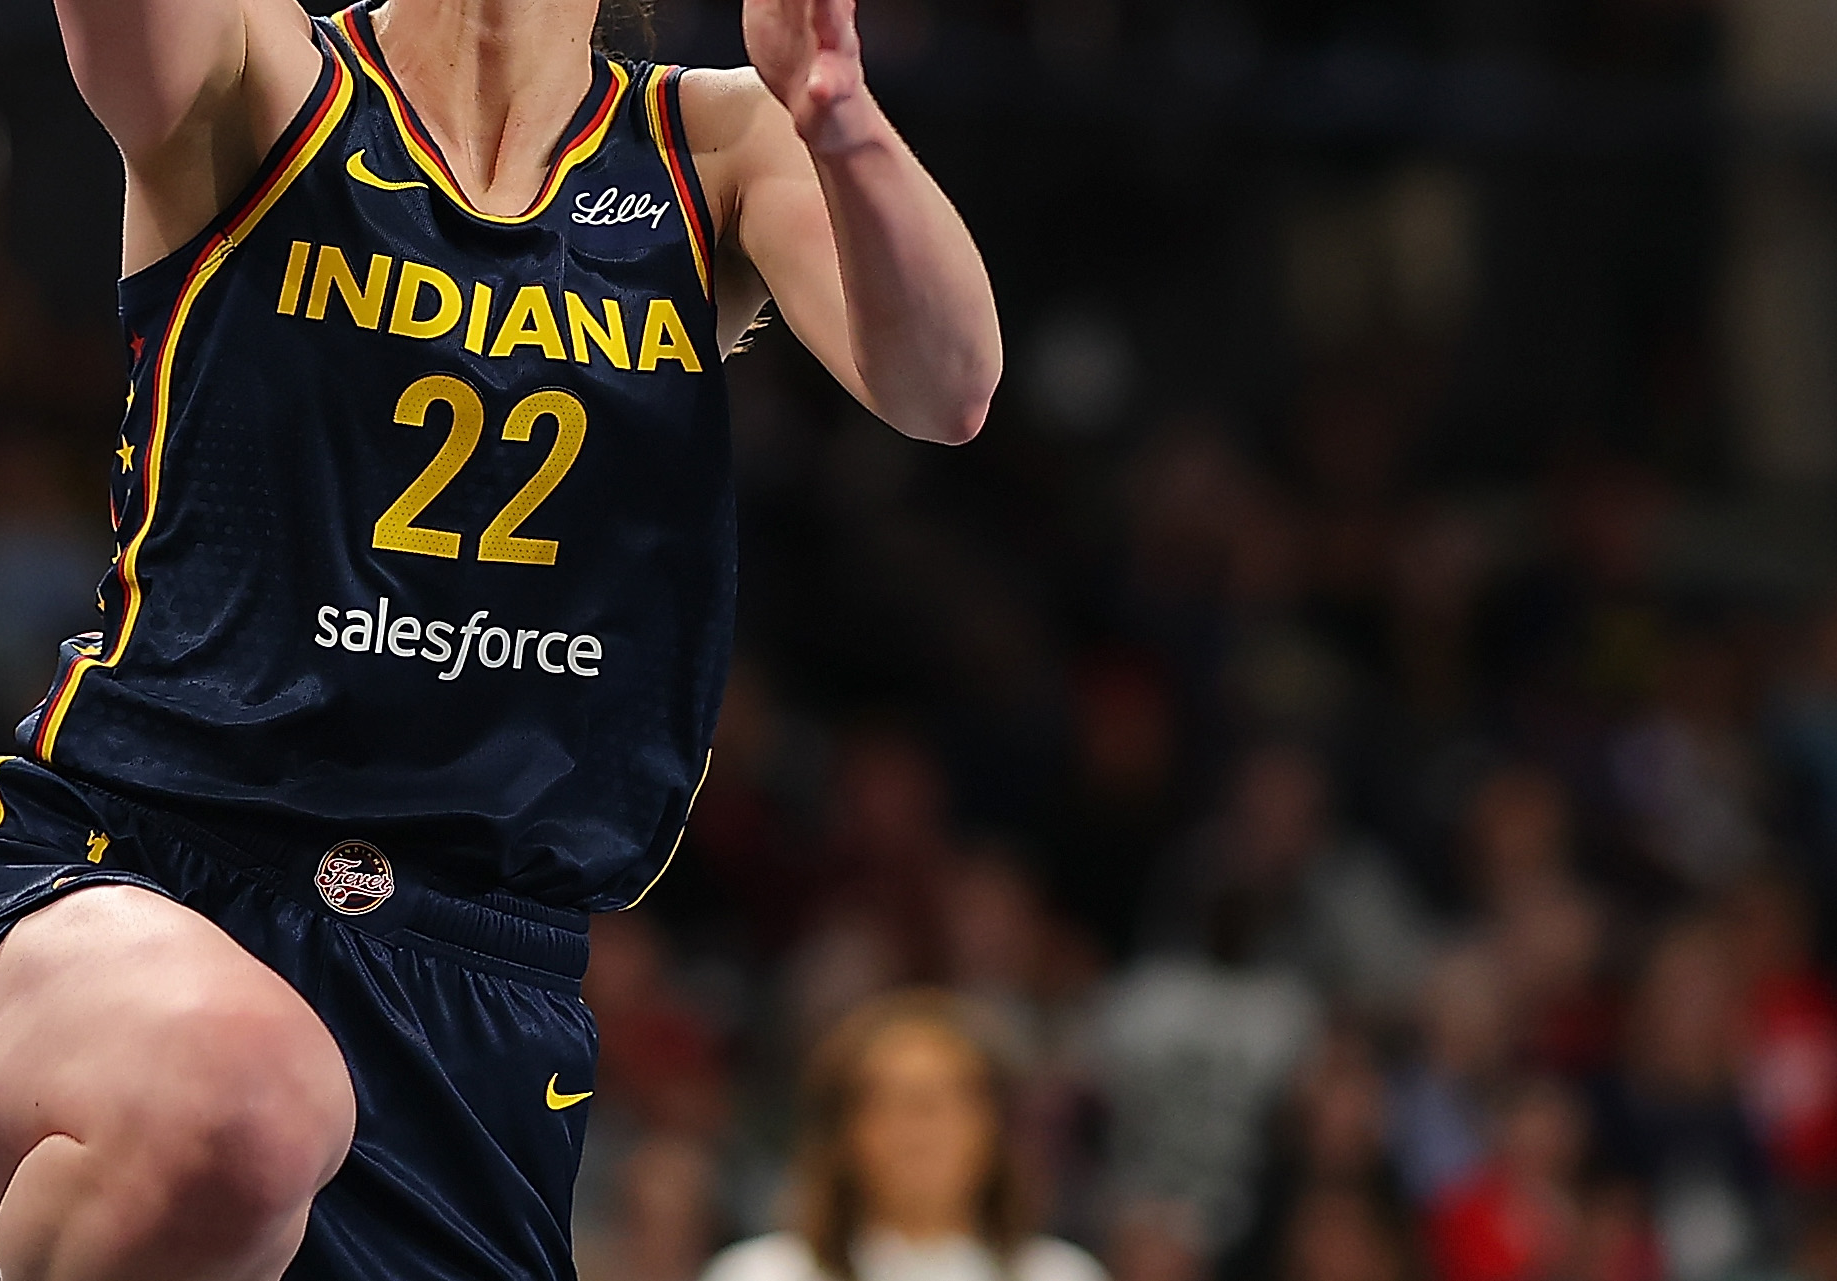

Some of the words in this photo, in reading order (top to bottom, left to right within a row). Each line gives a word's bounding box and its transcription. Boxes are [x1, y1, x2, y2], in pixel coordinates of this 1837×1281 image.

[570, 186, 672, 229] Lilly
[275, 239, 704, 373] INDIANA
[370, 373, 589, 567] 22
[313, 596, 604, 681] salesforce
[316, 858, 394, 895] Fever
[338, 846, 384, 873] INDIANA
